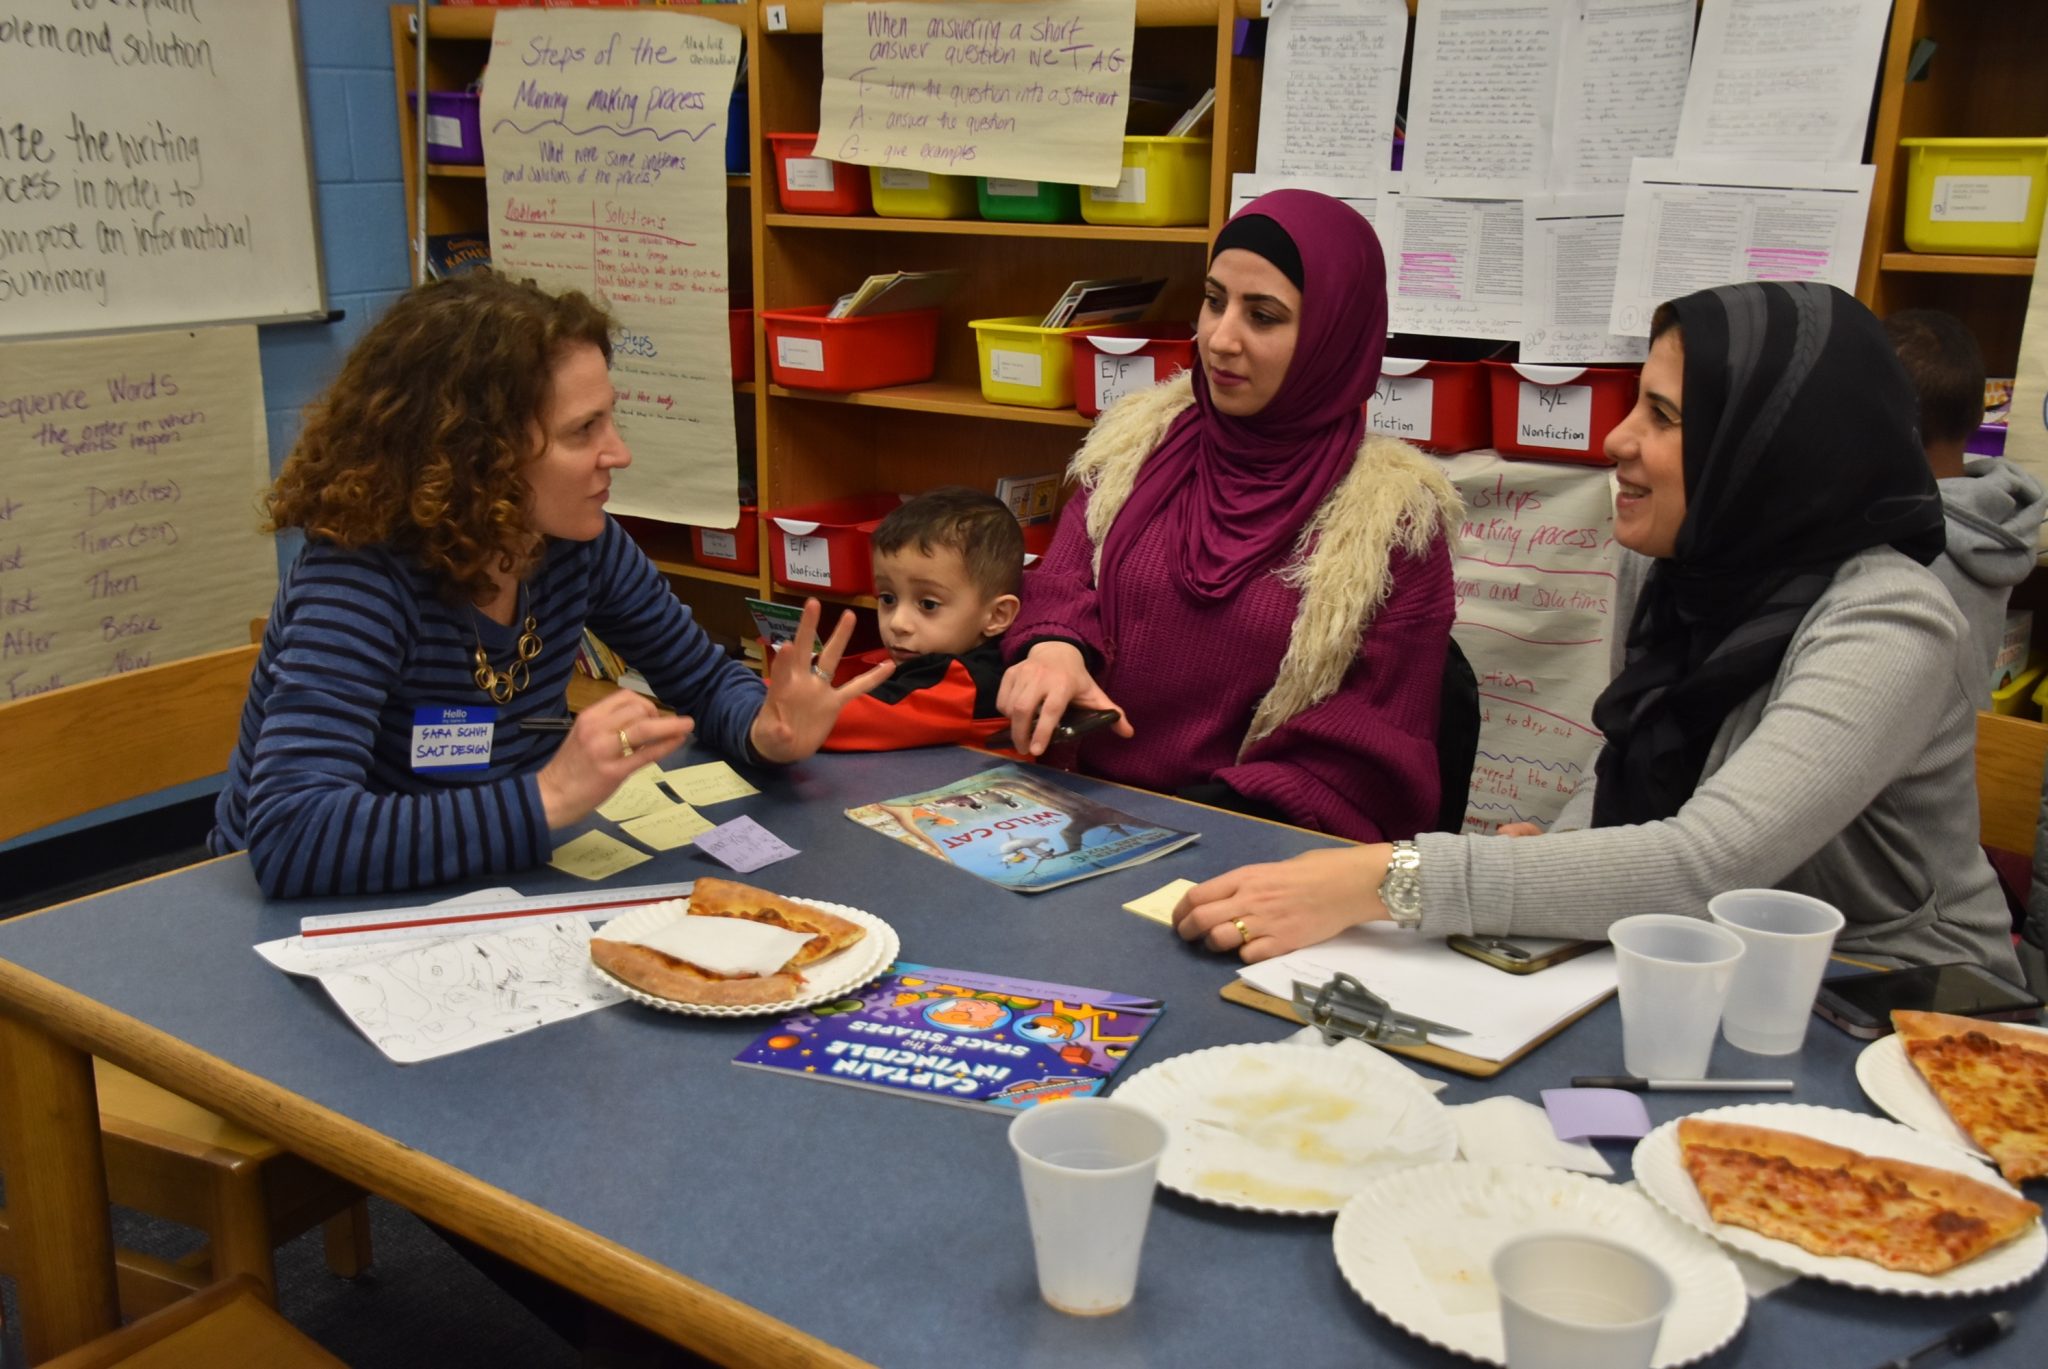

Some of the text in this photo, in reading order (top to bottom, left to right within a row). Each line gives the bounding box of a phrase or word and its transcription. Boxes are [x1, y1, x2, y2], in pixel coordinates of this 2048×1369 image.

[773, 11, 782, 25] 1
[867, 11, 1084, 43] When answering a short
[65, 21, 119, 66] and
[120, 29, 217, 78] solution
[521, 36, 585, 73] Steps
[594, 32, 621, 66] of
[631, 37, 677, 65] the
[869, 42, 929, 62] answer
[945, 46, 1016, 66] question
[886, 75, 916, 96] turn
[925, 77, 943, 98] the
[950, 82, 1011, 108] question
[1015, 82, 1044, 103] into
[586, 87, 639, 129] making
[644, 86, 705, 121] process
[886, 114, 929, 131] answer
[937, 114, 957, 130] the
[966, 117, 1016, 136] question
[65, 111, 112, 164] the
[115, 120, 204, 189] writing
[604, 150, 635, 168] some
[883, 145, 908, 165] give
[920, 144, 978, 167] examples
[503, 165, 524, 185] and
[0, 168, 197, 211] cess in order to
[0, 222, 86, 271] mpose
[130, 210, 253, 257] informational
[1102, 360, 1130, 387] E/F
[106, 372, 180, 404] Words
[1374, 382, 1402, 406] K/L
[1538, 389, 1568, 412] K/L
[32, 423, 68, 447] the
[1373, 412, 1415, 433] Fiction
[1521, 424, 1585, 441] Nonfiction
[1473, 473, 1542, 520] steps
[790, 539, 809, 556] E/F
[1459, 518, 1523, 566] making
[790, 563, 832, 579] Nonfiction
[84, 570, 139, 599] Then
[1488, 582, 1521, 601] and
[422, 727, 452, 741] SARA
[1505, 713, 1518, 726] to
[1522, 714, 1547, 737] dry
[1553, 725, 1573, 739] out
[450, 740, 490, 757] DESIGN
[1528, 768, 1549, 789] the
[941, 810, 1064, 850] WILD CAT
[847, 1020, 1030, 1056] SPACE SHAPES
[900, 1036, 958, 1055] and the
[825, 1040, 1012, 1081] INVINCIBLE
[831, 1058, 979, 1093] CAPTAIN
